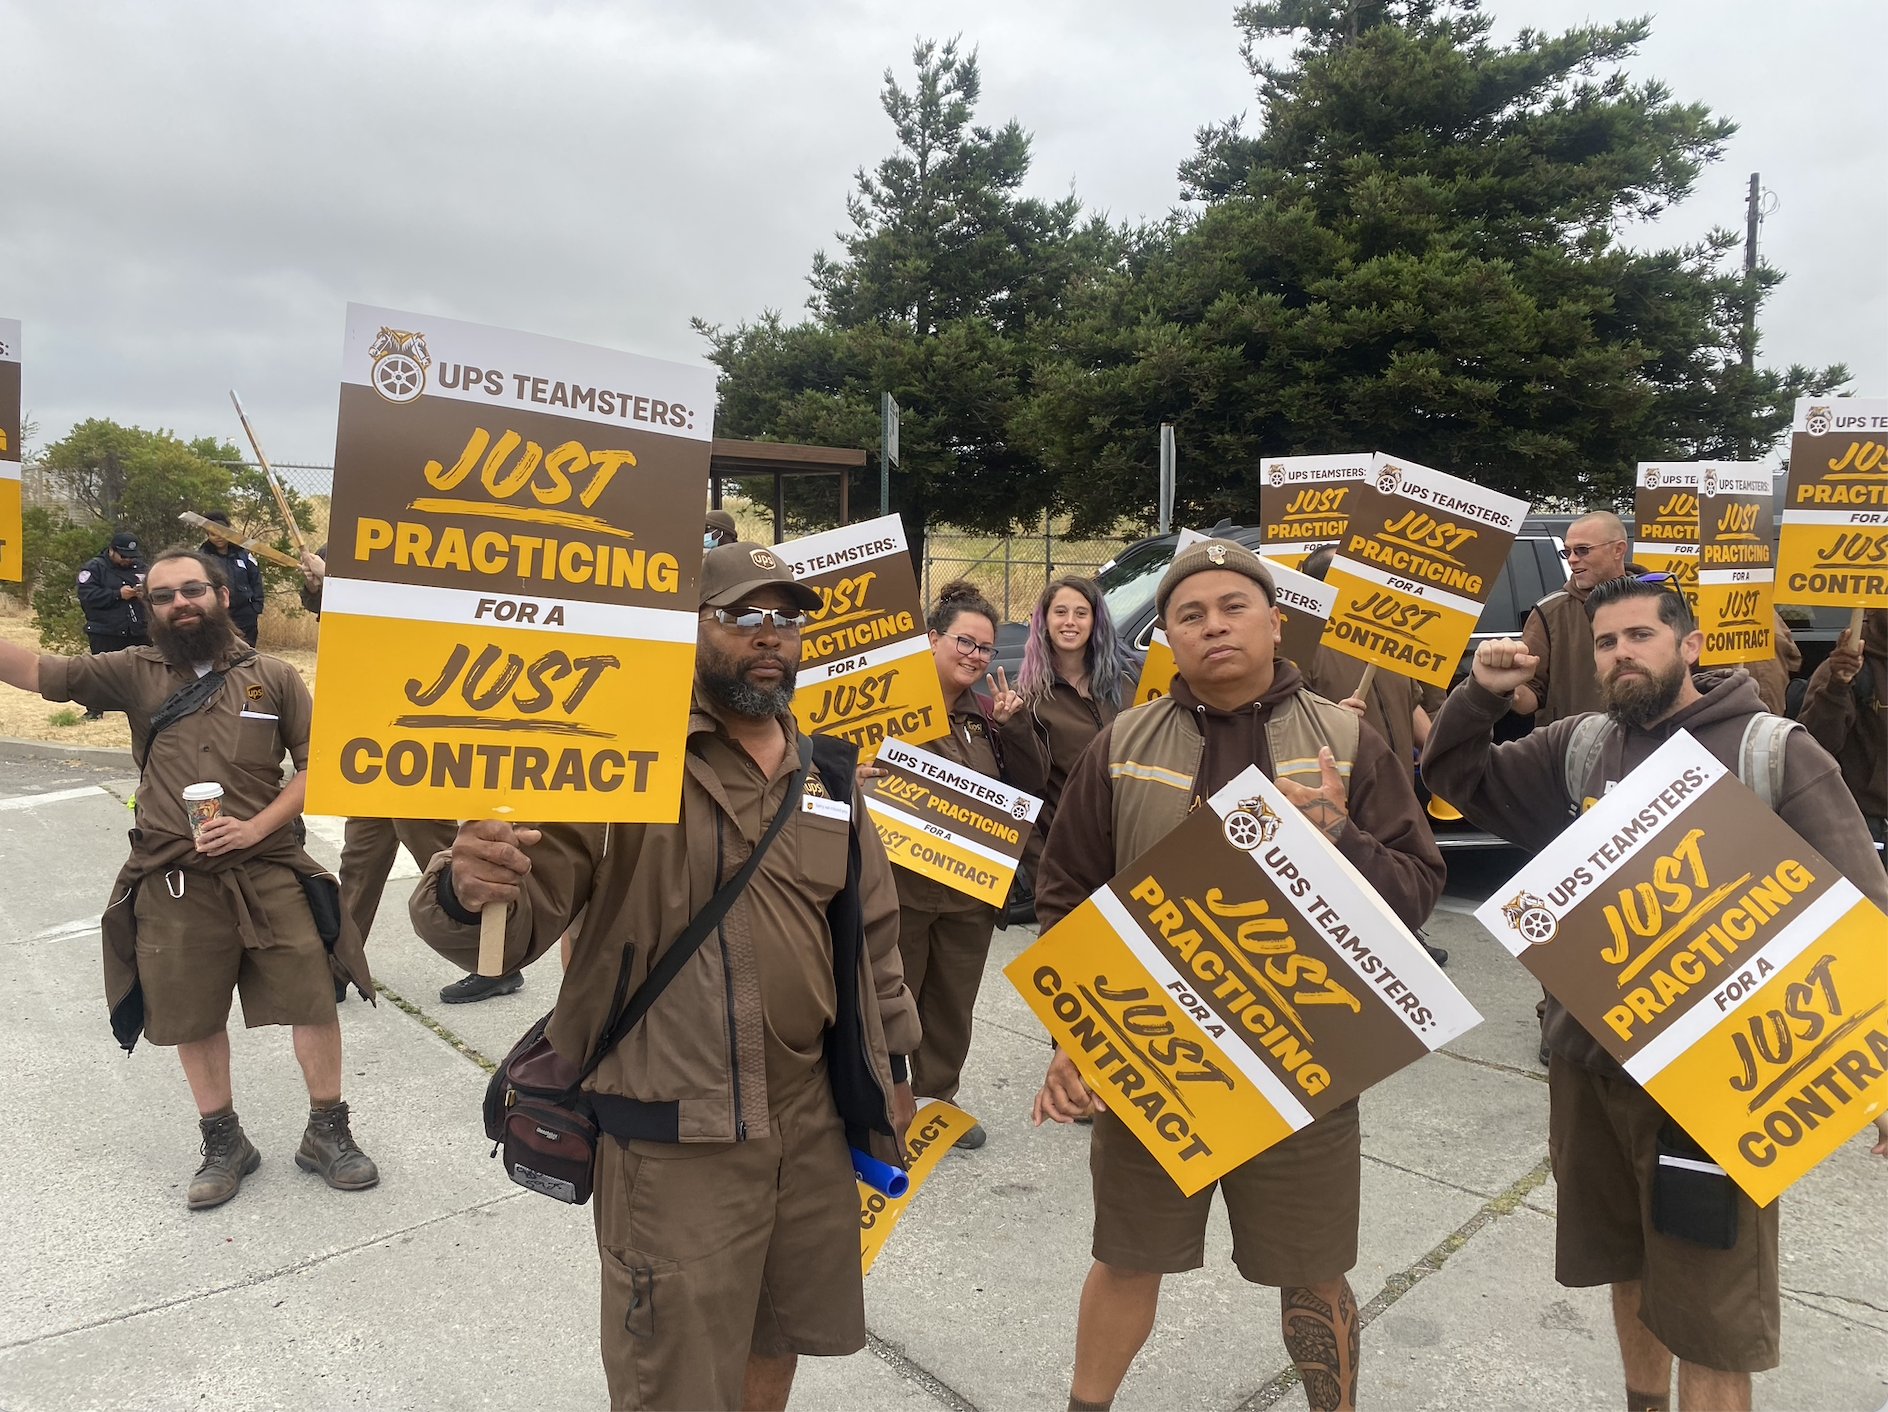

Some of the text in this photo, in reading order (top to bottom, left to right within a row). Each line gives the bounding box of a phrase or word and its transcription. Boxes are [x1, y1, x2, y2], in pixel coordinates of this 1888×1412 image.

[438, 361, 504, 397] UPS
[512, 373, 695, 431] TEAMSTERS:
[1836, 416, 1866, 428] UPS
[423, 426, 637, 508] JUST
[1289, 468, 1367, 480] UPS TEAMSTERS:
[1828, 441, 1888, 472] JU
[1286, 488, 1349, 513] JUST
[1663, 476, 1682, 484] UPS
[1720, 479, 1769, 492] UPS TEAMSTERS:
[1797, 484, 1888, 505] PRACTI
[1401, 482, 1513, 528] UPS TEAMSTERS:
[1659, 493, 1698, 516] JU
[1718, 503, 1760, 531] JUST
[1850, 513, 1881, 523] FOR
[1268, 520, 1348, 539] PRACTICI
[1383, 509, 1478, 551] JUST
[1641, 524, 1699, 539] PRACTI
[1817, 532, 1888, 562] JUS
[353, 517, 680, 594] PRACTICING
[753, 554, 774, 566] ups
[807, 537, 897, 572] TEAMSTERS:
[1348, 535, 1484, 594] PRACTICING
[1705, 545, 1769, 562] PRACTICING
[809, 571, 877, 620] UST
[1387, 576, 1425, 596] FOR A
[1733, 572, 1749, 582] FOR A
[1788, 573, 1888, 595] CONTR
[474, 598, 565, 626] FOR A
[1276, 587, 1322, 612] STERS:
[1352, 591, 1441, 633] JUST
[1719, 589, 1760, 619] JUST
[801, 610, 915, 661] ACTICING
[1324, 616, 1447, 673] CONTRACT
[1705, 628, 1770, 652] CONTRACT
[404, 643, 621, 714] JUST
[828, 657, 868, 677] FOR A
[247, 686, 262, 699] ups
[809, 669, 900, 723] JUST
[840, 705, 933, 749] TRACT
[339, 736, 659, 792] CONTRACT
[888, 749, 1009, 807] UPS TEAMSTERS:
[804, 783, 822, 796] ups
[878, 775, 1019, 845] JUST PRACTICING
[924, 824, 951, 841] FOR A
[1546, 765, 1711, 908] UPS TEAMSTERS:
[878, 824, 998, 889] UST CONTRACT
[1600, 827, 1711, 965] JUST
[1205, 887, 1362, 1015] JUST
[1264, 846, 1437, 1032] UPS TEAMSTERS:
[1602, 858, 1816, 1042] PRACTICING
[1129, 875, 1331, 1097] PRACTICING
[1713, 956, 1775, 1012] FOR A
[1166, 980, 1226, 1039] FOR A
[1729, 953, 1844, 1093] JUST
[1095, 974, 1235, 1092] JUST
[1032, 965, 1212, 1163] CONTRACT
[1737, 1017, 1888, 1168] CONTRA
[861, 1115, 949, 1229] CORACT
